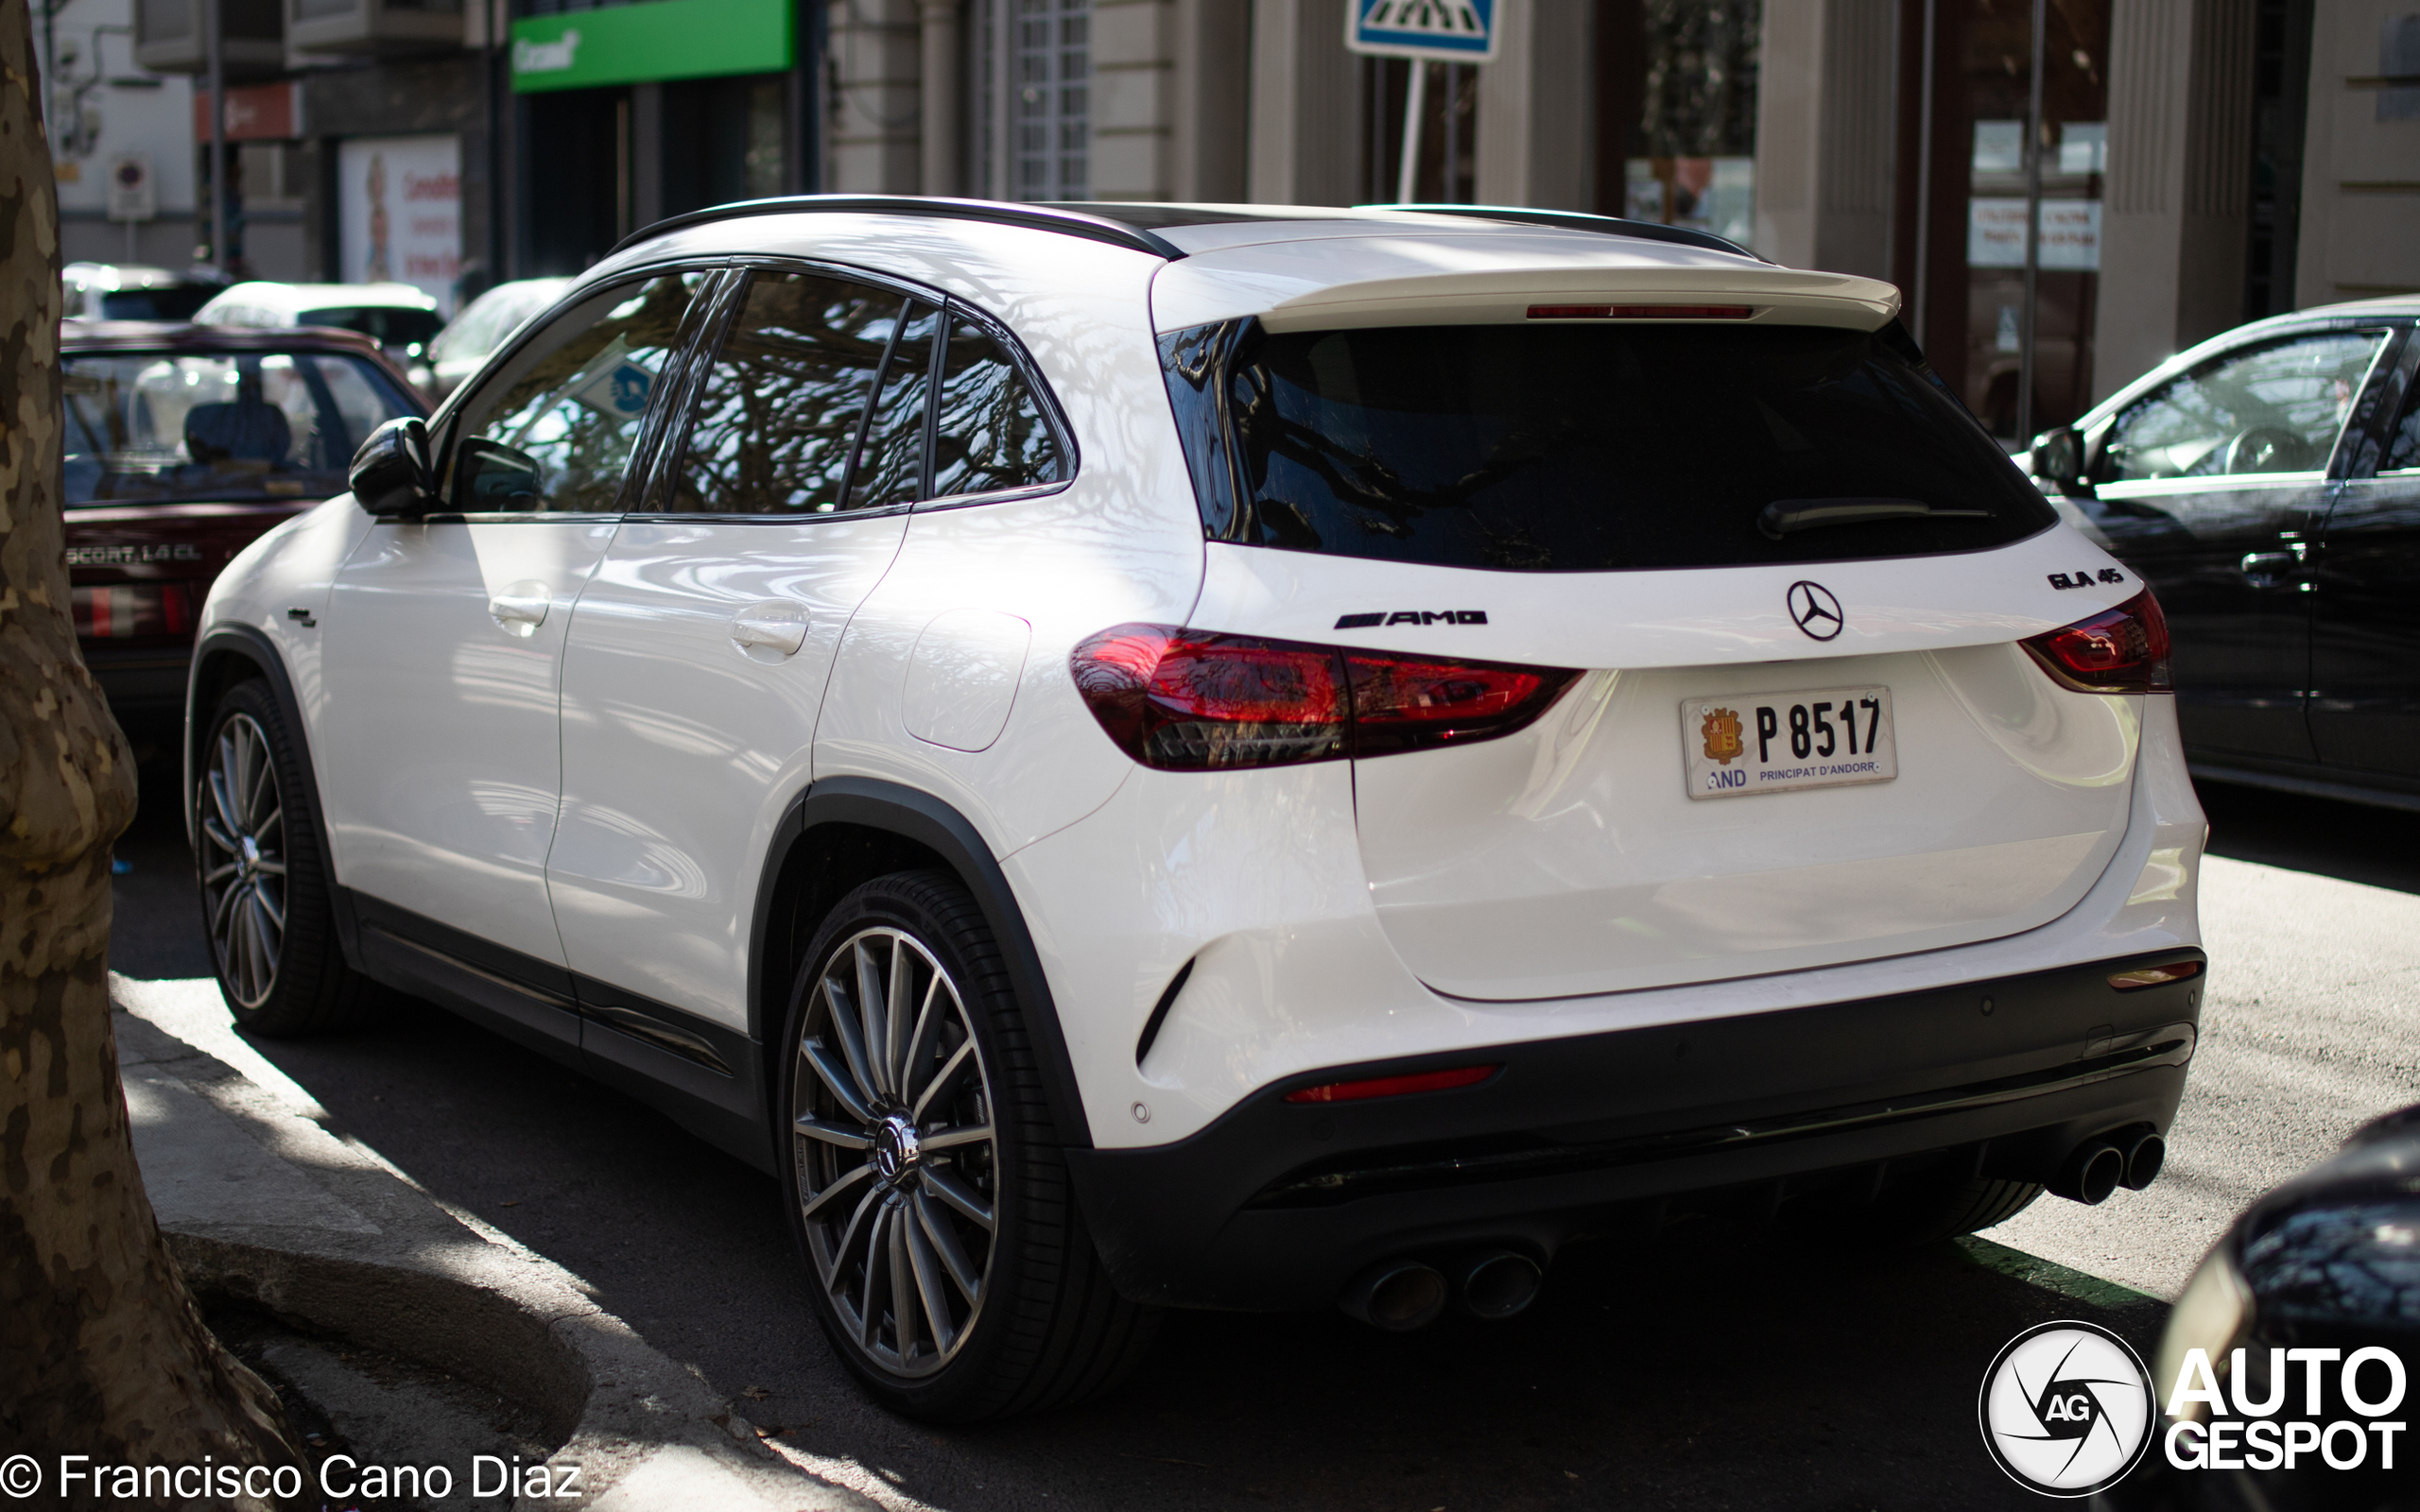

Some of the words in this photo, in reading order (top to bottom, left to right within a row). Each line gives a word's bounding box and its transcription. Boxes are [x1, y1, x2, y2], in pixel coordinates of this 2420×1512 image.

[65, 546, 134, 565] SCORT
[2097, 568, 2124, 584] 45
[1755, 706, 1777, 763] P
[1789, 697, 1879, 759] 8517
[1759, 766, 1817, 782] PRINCIPAT
[1820, 762, 1881, 775] D'ANDORR
